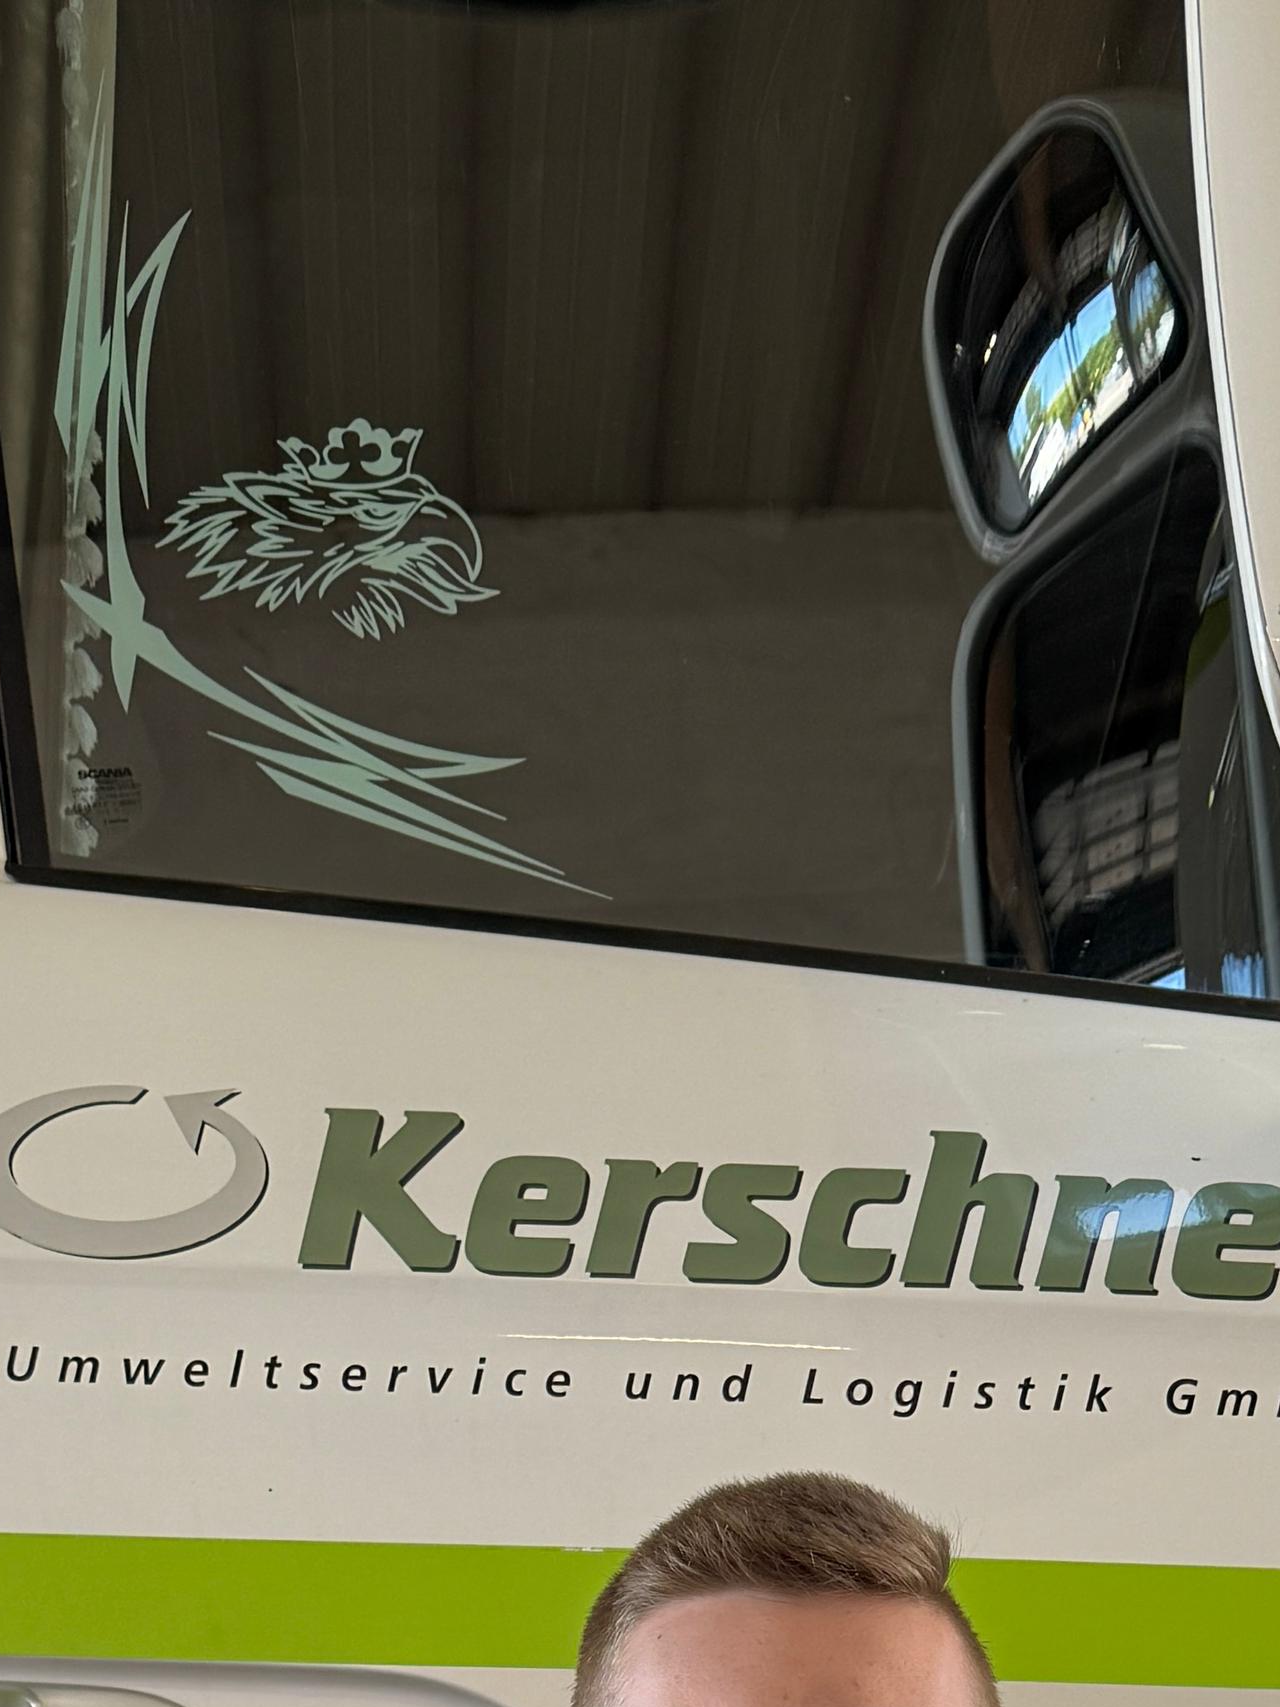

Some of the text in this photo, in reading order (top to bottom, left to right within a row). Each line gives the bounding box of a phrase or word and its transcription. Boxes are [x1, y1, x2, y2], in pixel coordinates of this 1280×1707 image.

[5, 1345, 572, 1398] Umweltservice
[625, 1363, 754, 1402] und
[801, 1368, 1113, 1418] Logistik
